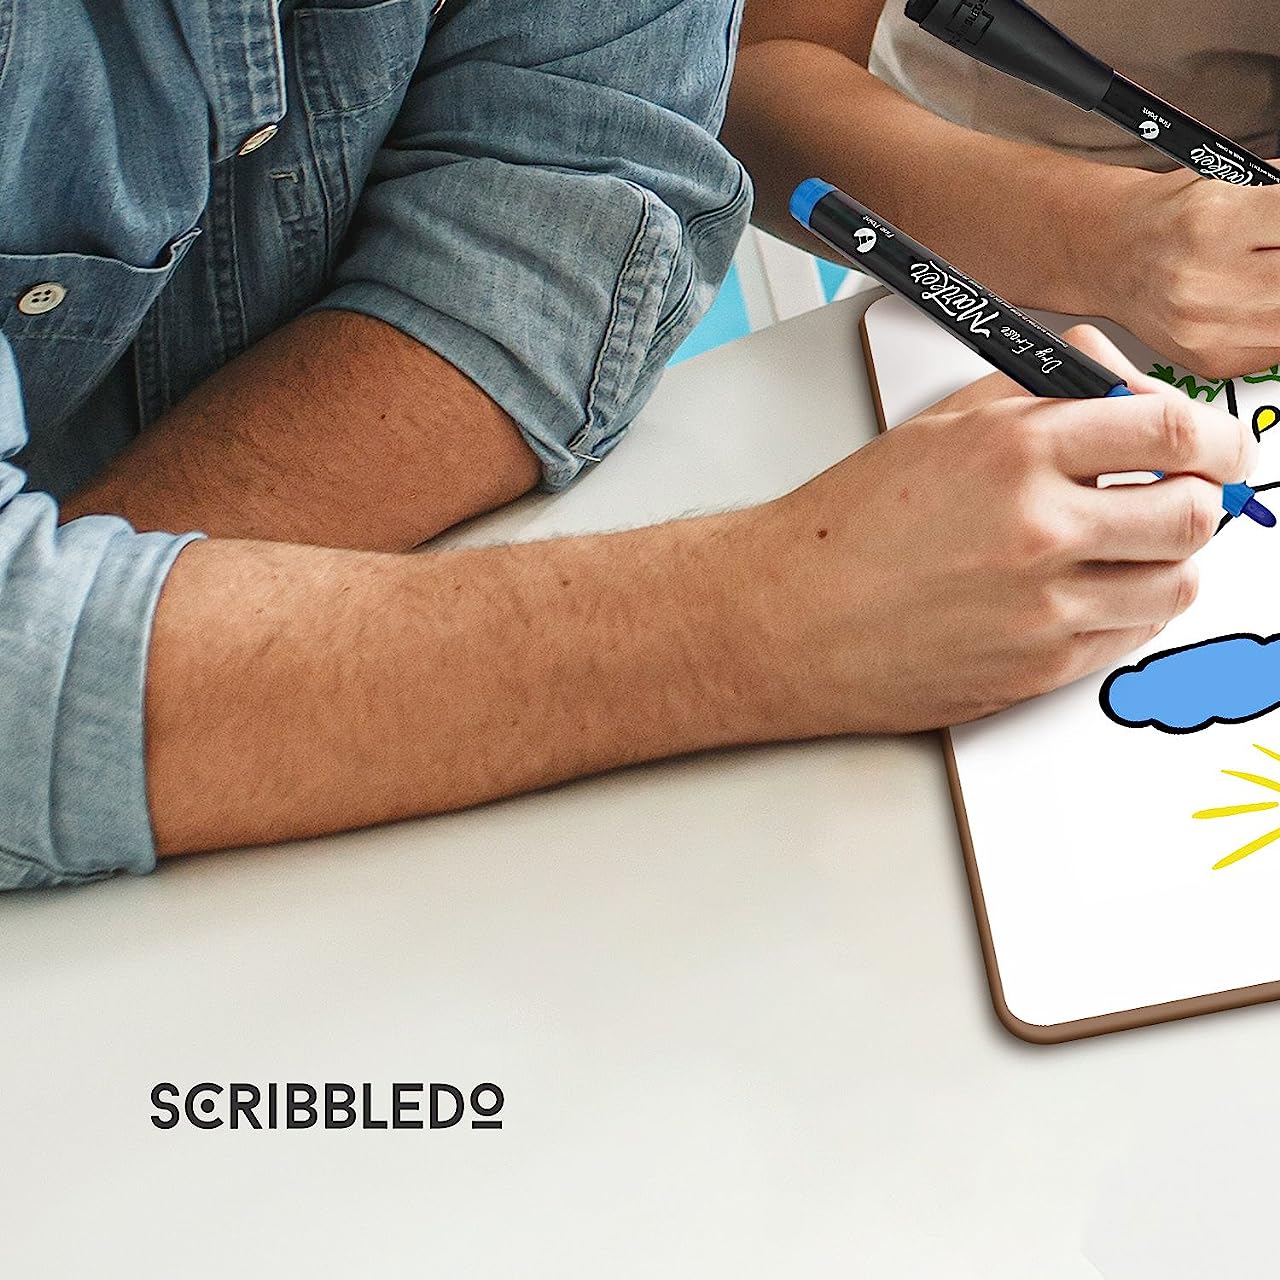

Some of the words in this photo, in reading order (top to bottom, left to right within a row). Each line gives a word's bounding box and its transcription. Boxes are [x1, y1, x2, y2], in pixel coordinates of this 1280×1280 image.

[910, 260, 999, 339] Marker
[1000, 326, 1034, 355] Erase
[1034, 347, 1063, 374] Dry
